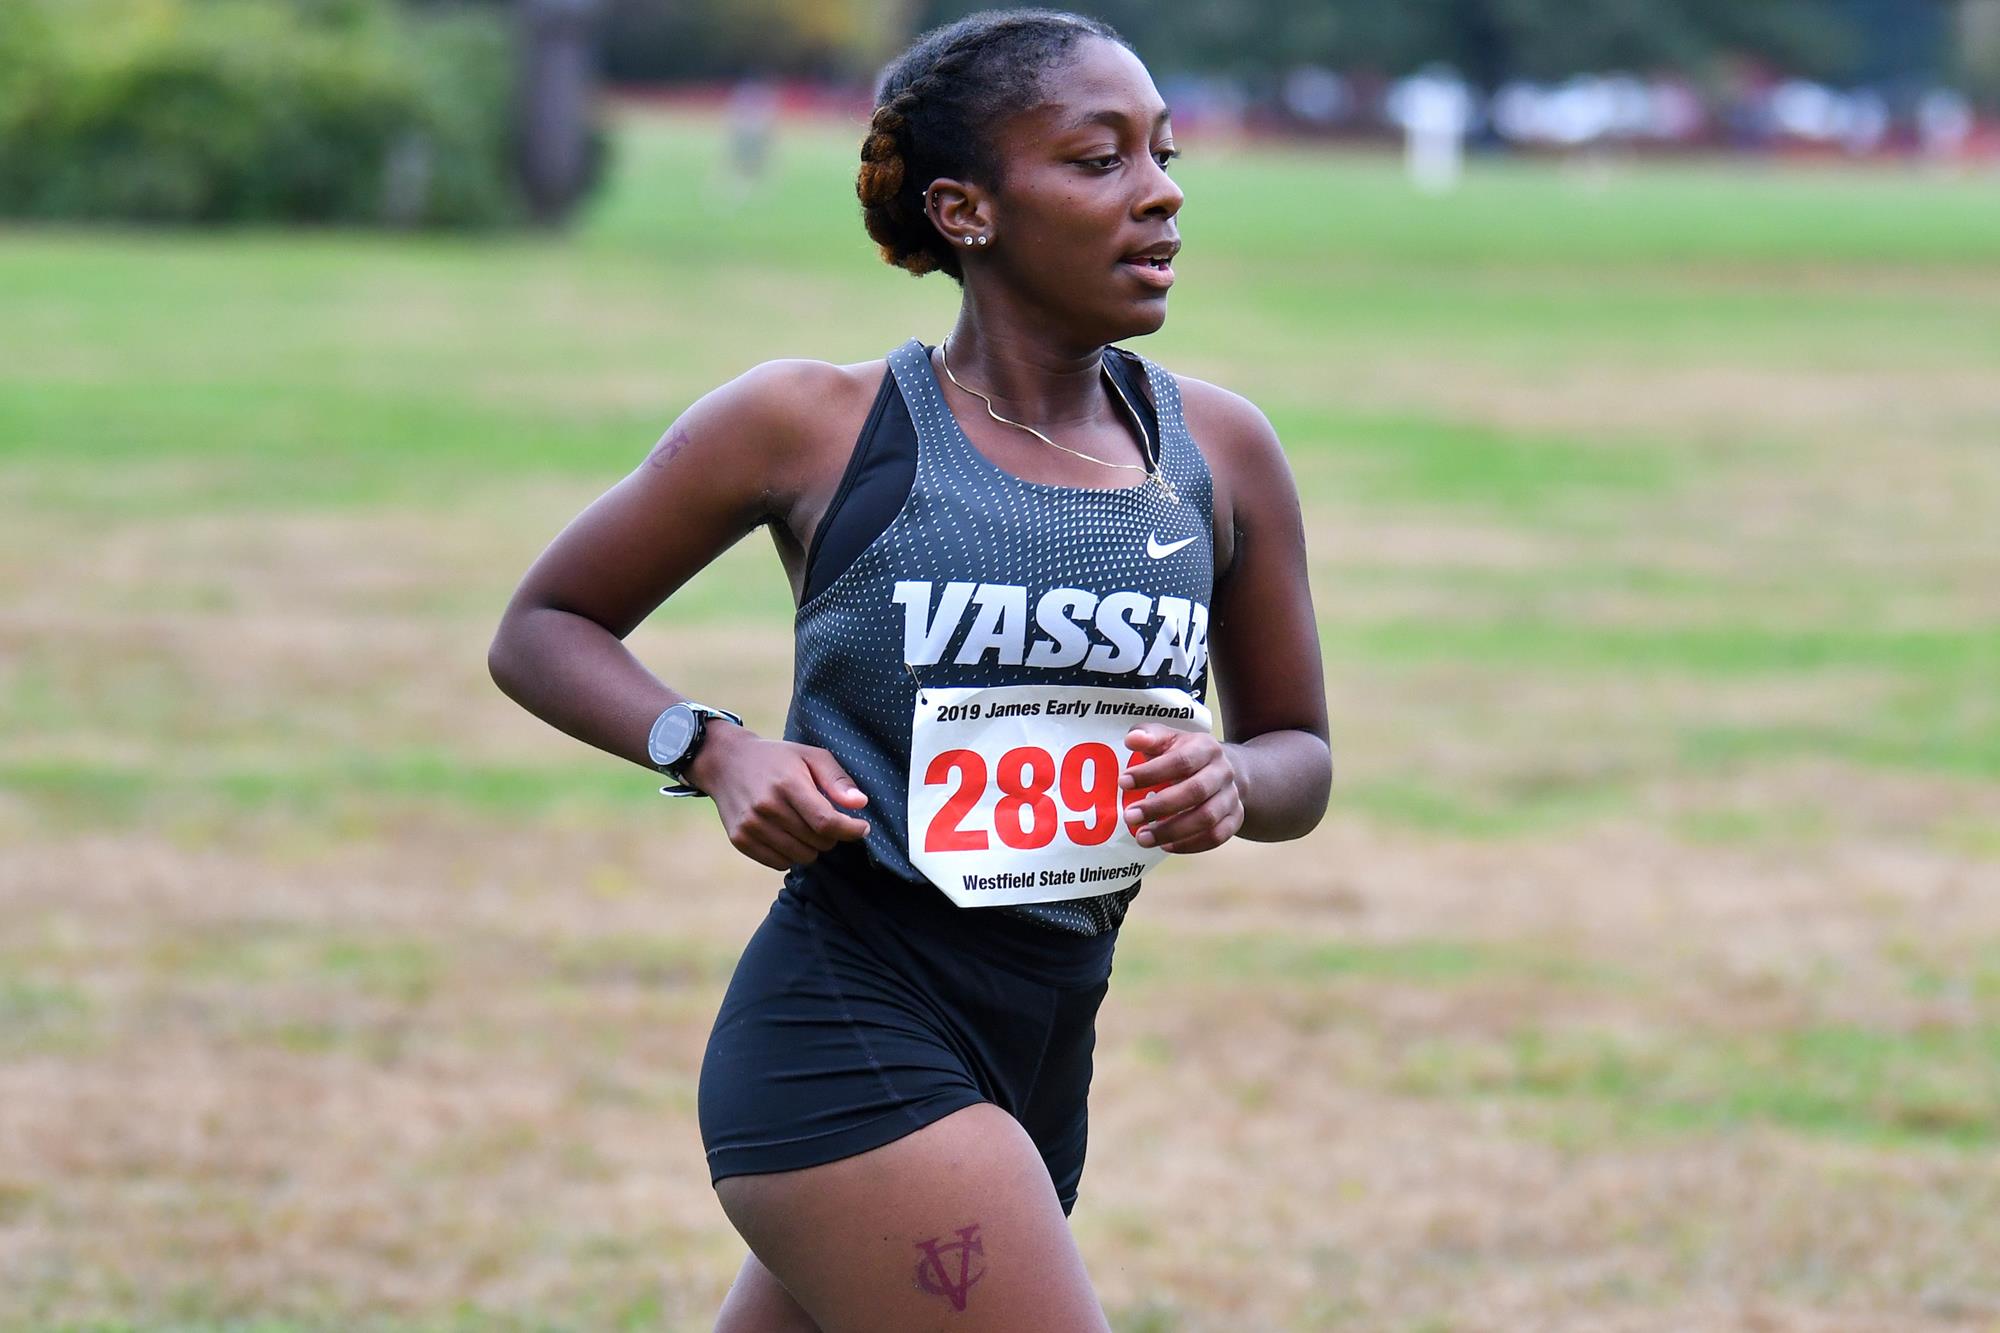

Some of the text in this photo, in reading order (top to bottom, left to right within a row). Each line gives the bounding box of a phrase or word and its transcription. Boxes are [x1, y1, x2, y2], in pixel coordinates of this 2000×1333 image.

[936, 699, 1195, 722] 2019 James Early Invitational
[962, 862, 1146, 891] Westfield State University
